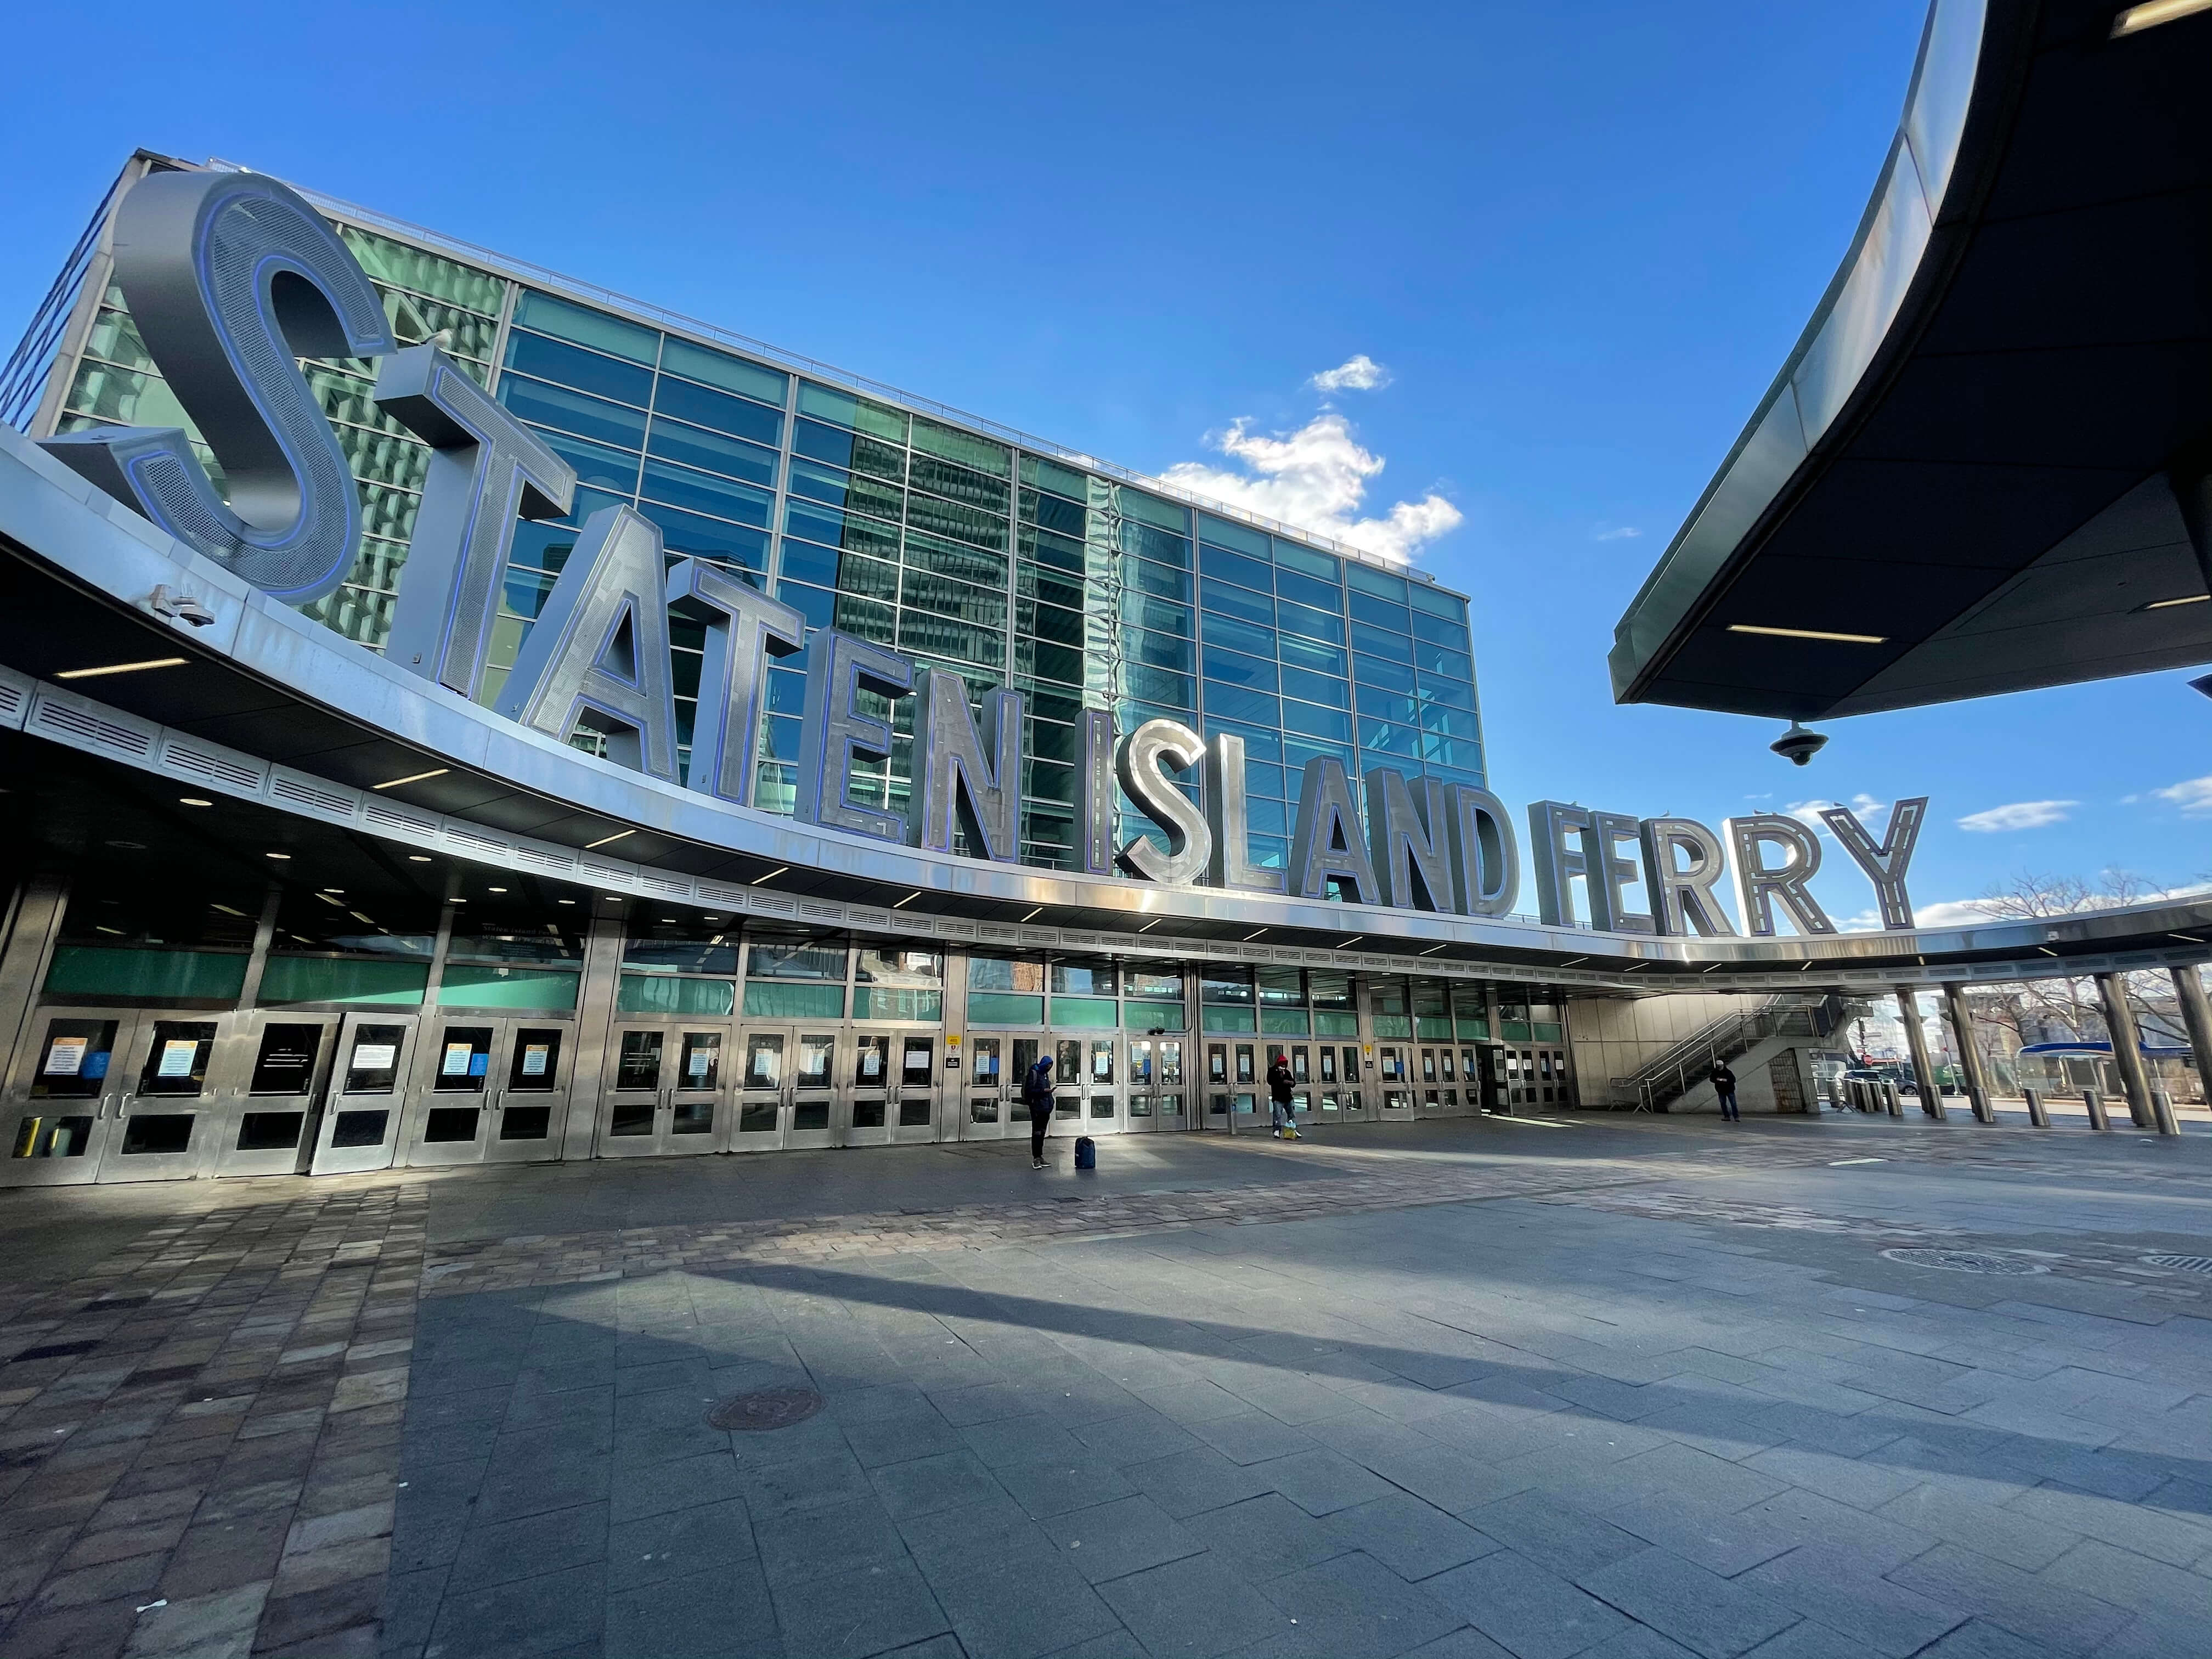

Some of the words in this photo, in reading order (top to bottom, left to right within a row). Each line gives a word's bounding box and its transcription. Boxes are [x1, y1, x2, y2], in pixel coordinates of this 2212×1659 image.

[42, 171, 1025, 864] STATEN
[1074, 706, 1520, 919] ISLAND
[1527, 796, 1929, 938] FERRY
